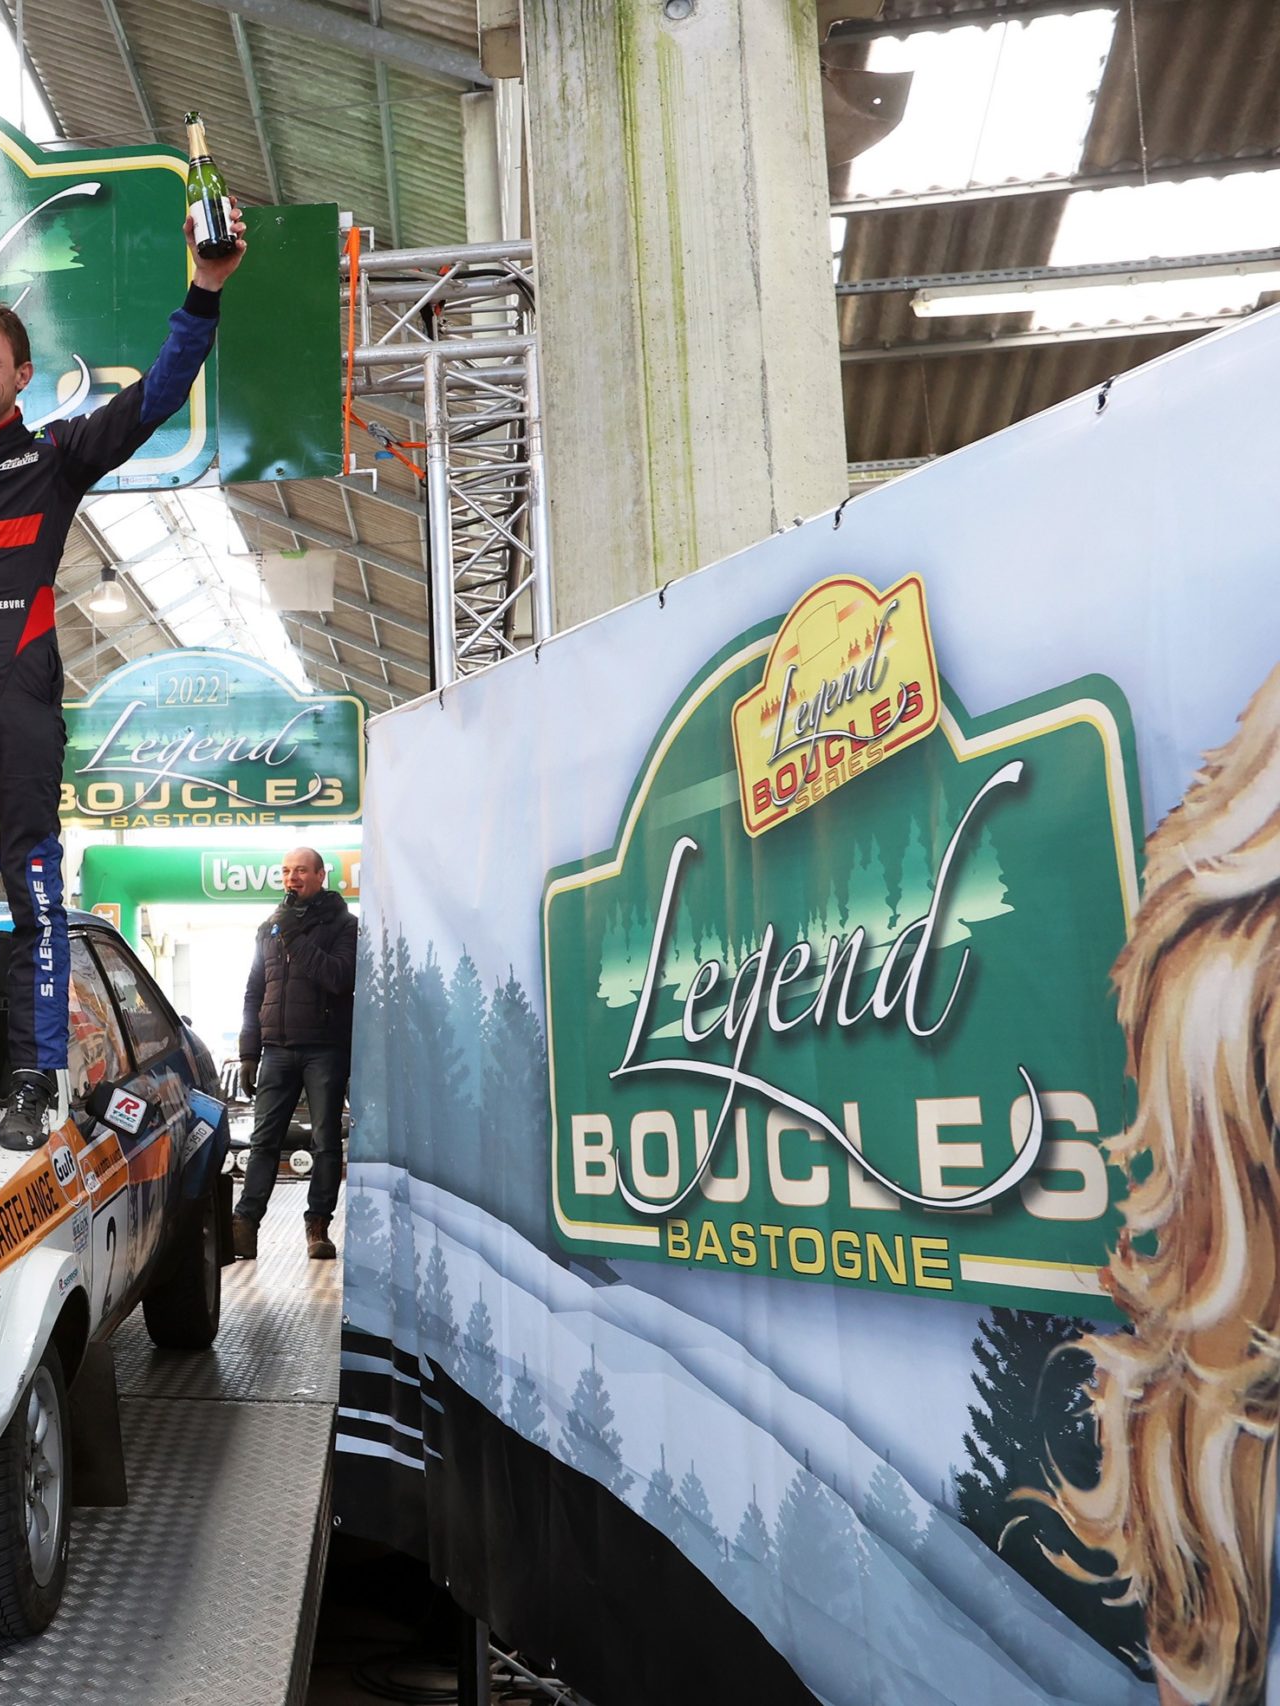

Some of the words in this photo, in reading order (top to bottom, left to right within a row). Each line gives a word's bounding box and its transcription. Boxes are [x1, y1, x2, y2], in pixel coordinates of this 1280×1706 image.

[165, 676, 220, 705] 2022
[75, 700, 326, 816] Legend
[751, 681, 924, 816] BOUCLES
[794, 742, 886, 814] SERIES
[110, 812, 276, 828] BASTOGNE
[609, 759, 1045, 1214] Legend
[53, 1153, 76, 1183] Gulf
[570, 1090, 1110, 1221] BOUCLES
[666, 1219, 954, 1292] BASTOGNE
